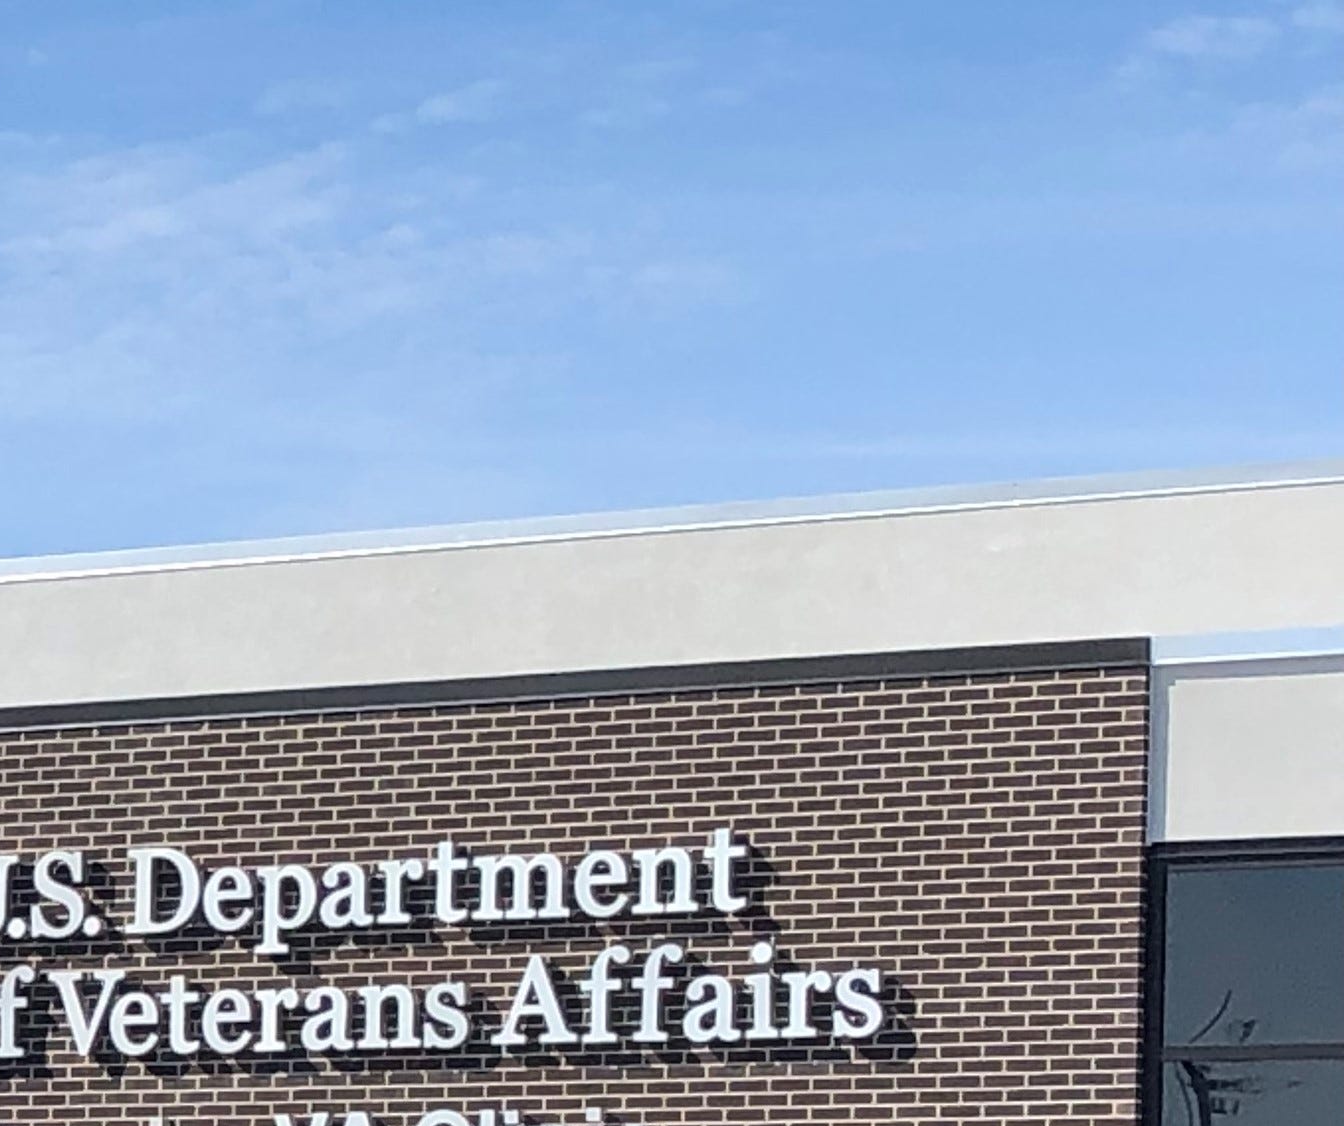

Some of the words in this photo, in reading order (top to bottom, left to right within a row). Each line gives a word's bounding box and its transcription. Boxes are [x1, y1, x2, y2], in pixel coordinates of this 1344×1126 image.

[124, 827, 749, 956] Department
[48, 968, 470, 1059] Veterans
[491, 942, 885, 1047] Affairs
